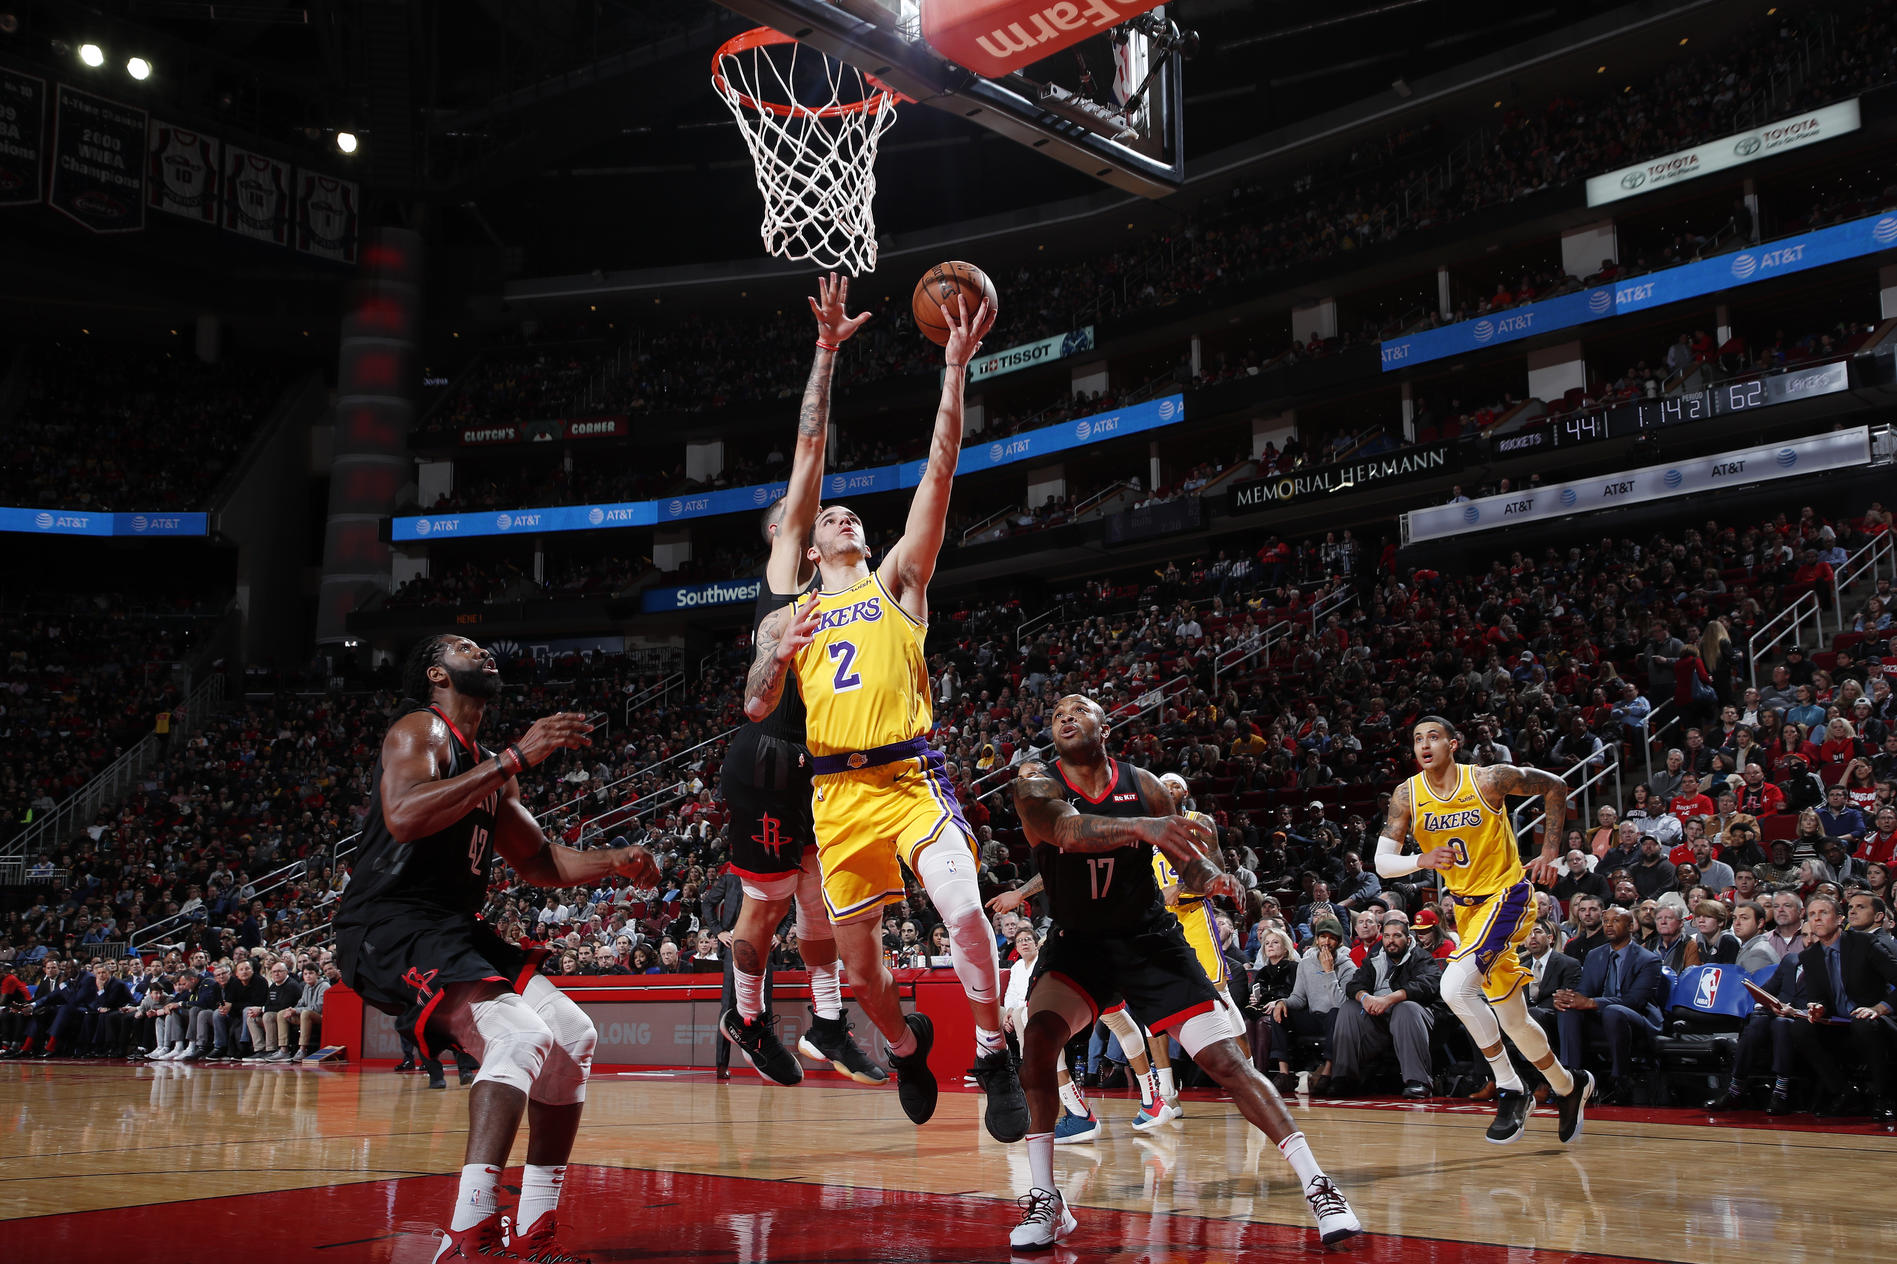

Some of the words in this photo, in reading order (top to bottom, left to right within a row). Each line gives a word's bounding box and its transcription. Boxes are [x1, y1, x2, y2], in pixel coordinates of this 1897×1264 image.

[976, 0, 1120, 57] Farm
[1762, 118, 1820, 141] TOYOTA
[78, 143, 125, 169] WNBA
[1647, 154, 1699, 177] TOYOTA
[62, 154, 140, 189] Champions
[1760, 245, 1806, 270] AT&T
[1616, 283, 1655, 303] AT&T
[1498, 313, 1534, 332] AT&T
[1000, 344, 1051, 368] TISSOT
[1681, 391, 1704, 402] PERIOD
[1729, 381, 1761, 410] 62
[1689, 400, 1700, 418] 2
[464, 428, 515, 442] CLUTCH'S
[571, 421, 616, 434] CORNER
[1093, 417, 1120, 434] AT&T
[1566, 416, 1596, 440] 44
[1005, 439, 1031, 456] AT&T
[1500, 432, 1543, 451] ROCKETS
[1237, 472, 1334, 507] MEMORIAL
[1341, 449, 1446, 484] HERMANN
[1711, 460, 1746, 477] AT&T
[849, 475, 875, 488] AT&T
[1603, 480, 1636, 497] AT&T
[607, 509, 634, 521] AT&T
[684, 499, 710, 511] AT&T
[1504, 499, 1534, 516] AT&T
[56, 518, 88, 528] AT&T
[150, 519, 180, 529] AT&T
[433, 520, 459, 531] AT&T
[514, 515, 541, 527] AT&T
[677, 582, 760, 606] Southwest
[828, 640, 863, 694] 2
[1424, 809, 1482, 832] LAKERS
[468, 824, 488, 876] 42
[1448, 837, 1471, 868] 0
[1087, 858, 1115, 900] 17
